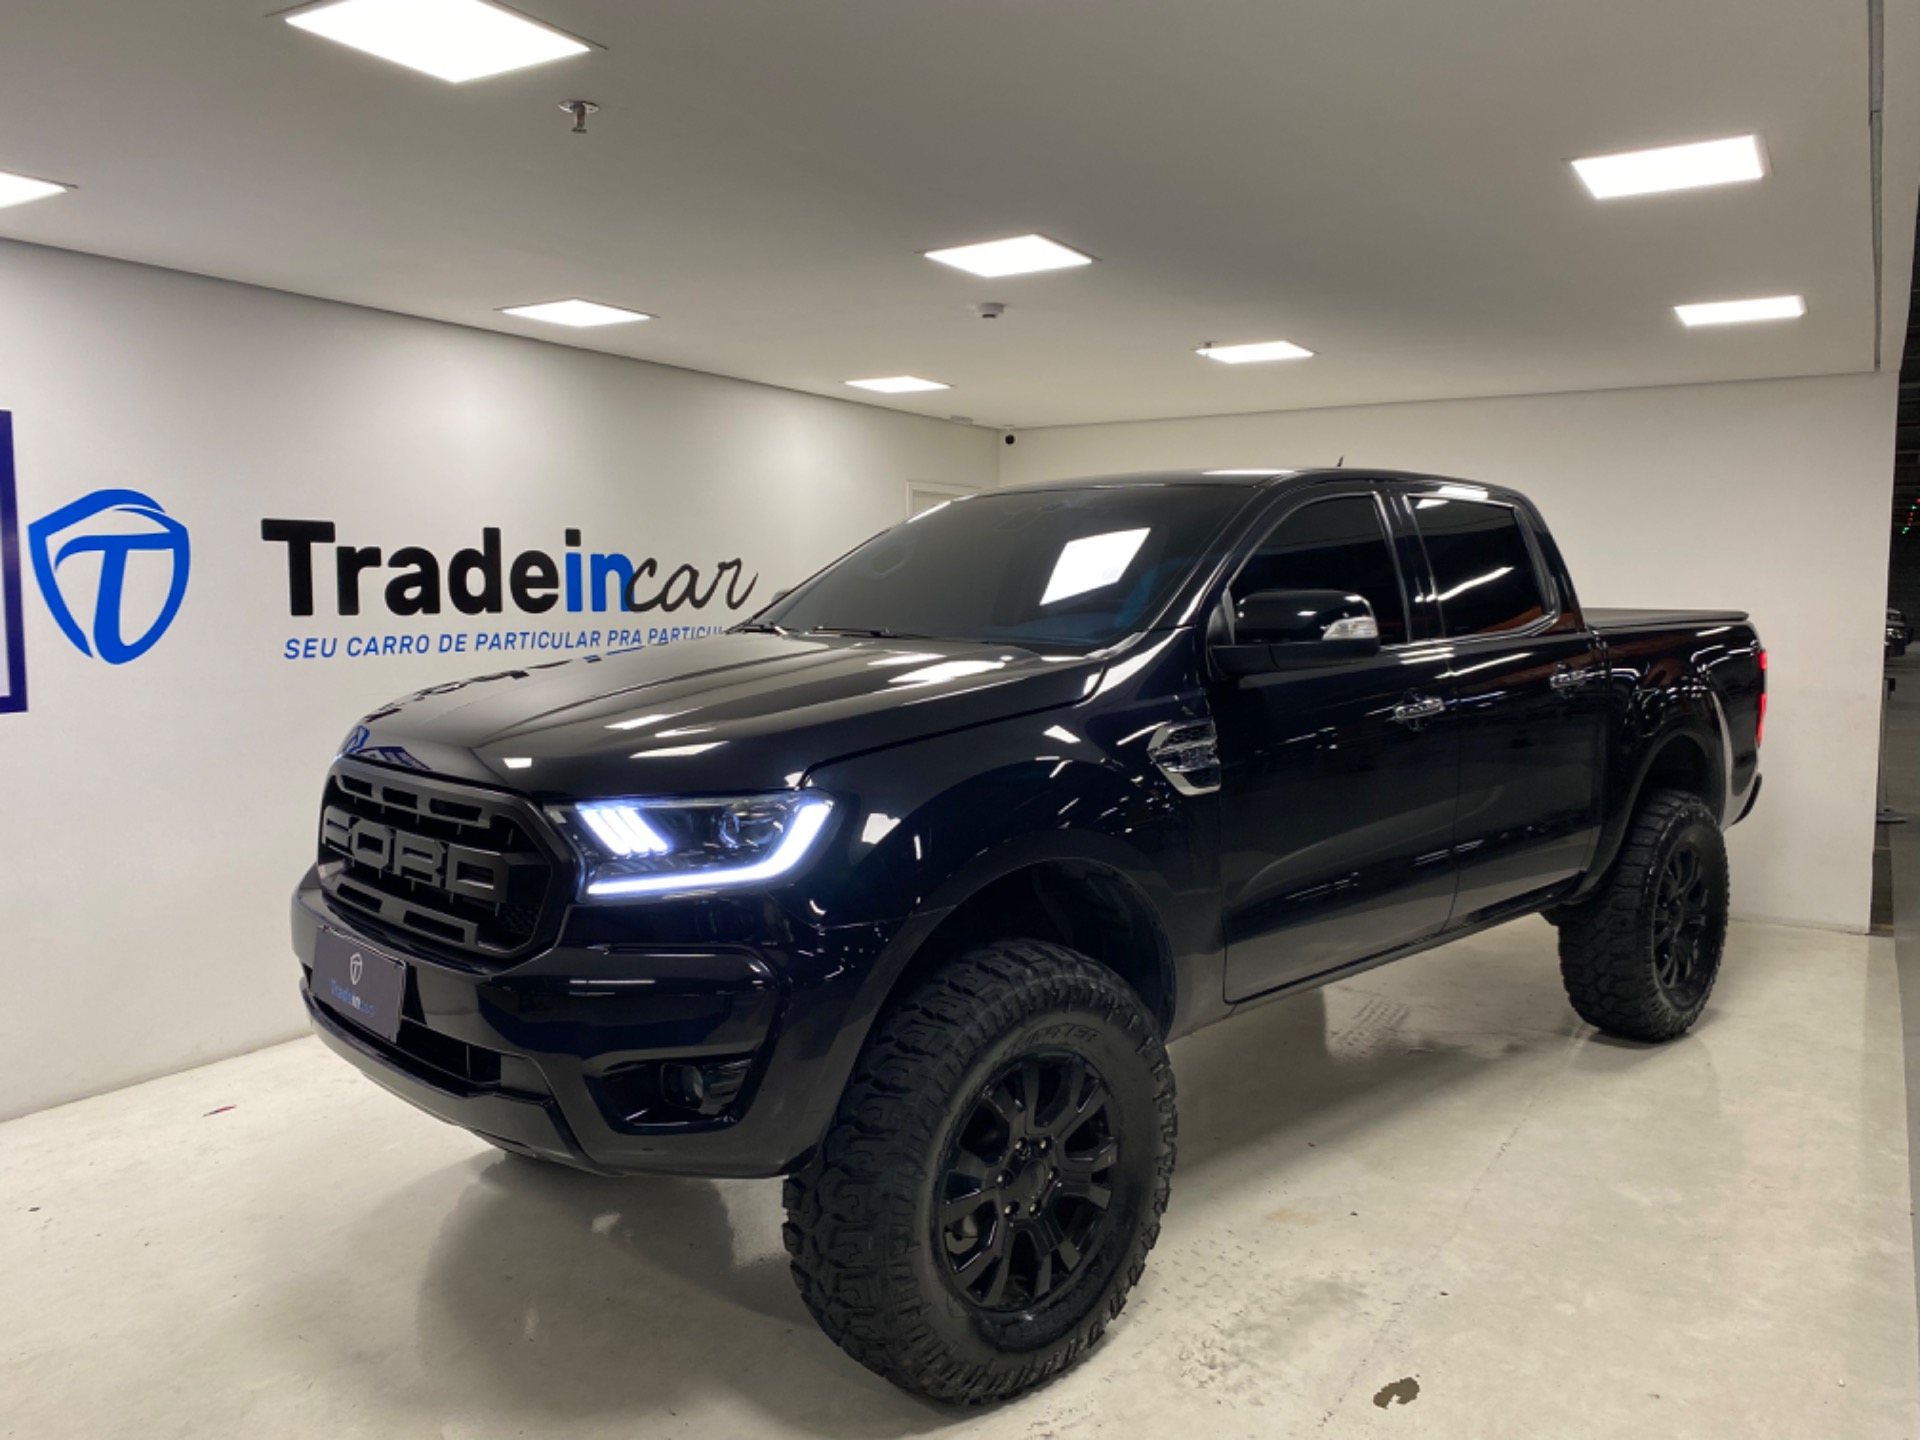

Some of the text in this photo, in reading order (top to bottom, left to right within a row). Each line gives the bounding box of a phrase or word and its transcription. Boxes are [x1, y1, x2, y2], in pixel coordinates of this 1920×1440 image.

[284, 637, 338, 660] SEU
[346, 634, 431, 657] CARRO
[438, 633, 468, 653] DE
[474, 629, 602, 651] PARTICULAR
[607, 628, 643, 646] PRA
[322, 805, 509, 903] FORD
